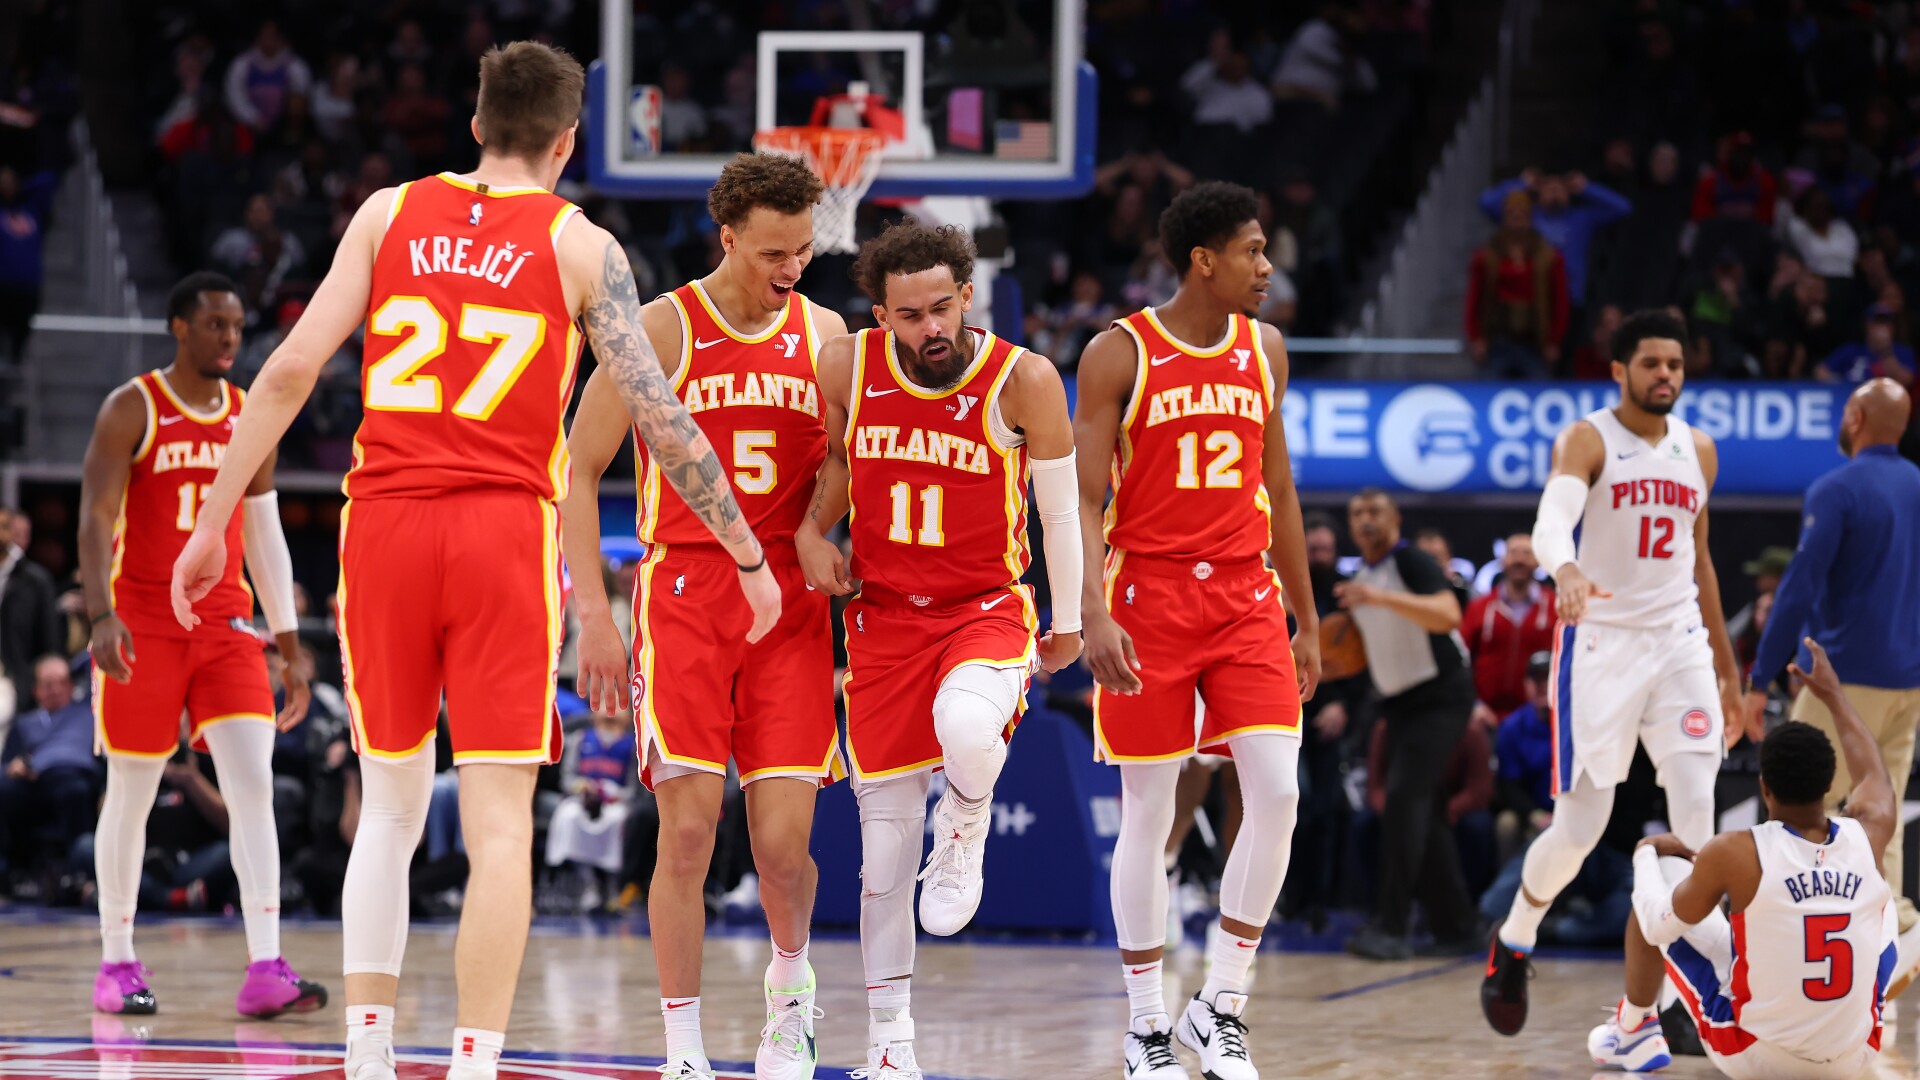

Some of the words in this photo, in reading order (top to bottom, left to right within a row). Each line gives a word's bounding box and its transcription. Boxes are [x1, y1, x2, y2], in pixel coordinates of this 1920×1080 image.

[408, 236, 535, 288] KREJČÍ
[365, 295, 547, 421] 27
[684, 372, 819, 419] ATLANTA
[1146, 383, 1264, 428] ATLANTA
[733, 430, 777, 494] 5
[856, 426, 990, 475] ATLANTA
[1176, 430, 1243, 489] 12
[888, 481, 945, 547] 11
[1611, 478, 1698, 515] PISTONS
[1638, 515, 1675, 559] 12
[1785, 870, 1862, 903] BEASLEY
[1802, 913, 1853, 1001] 5
